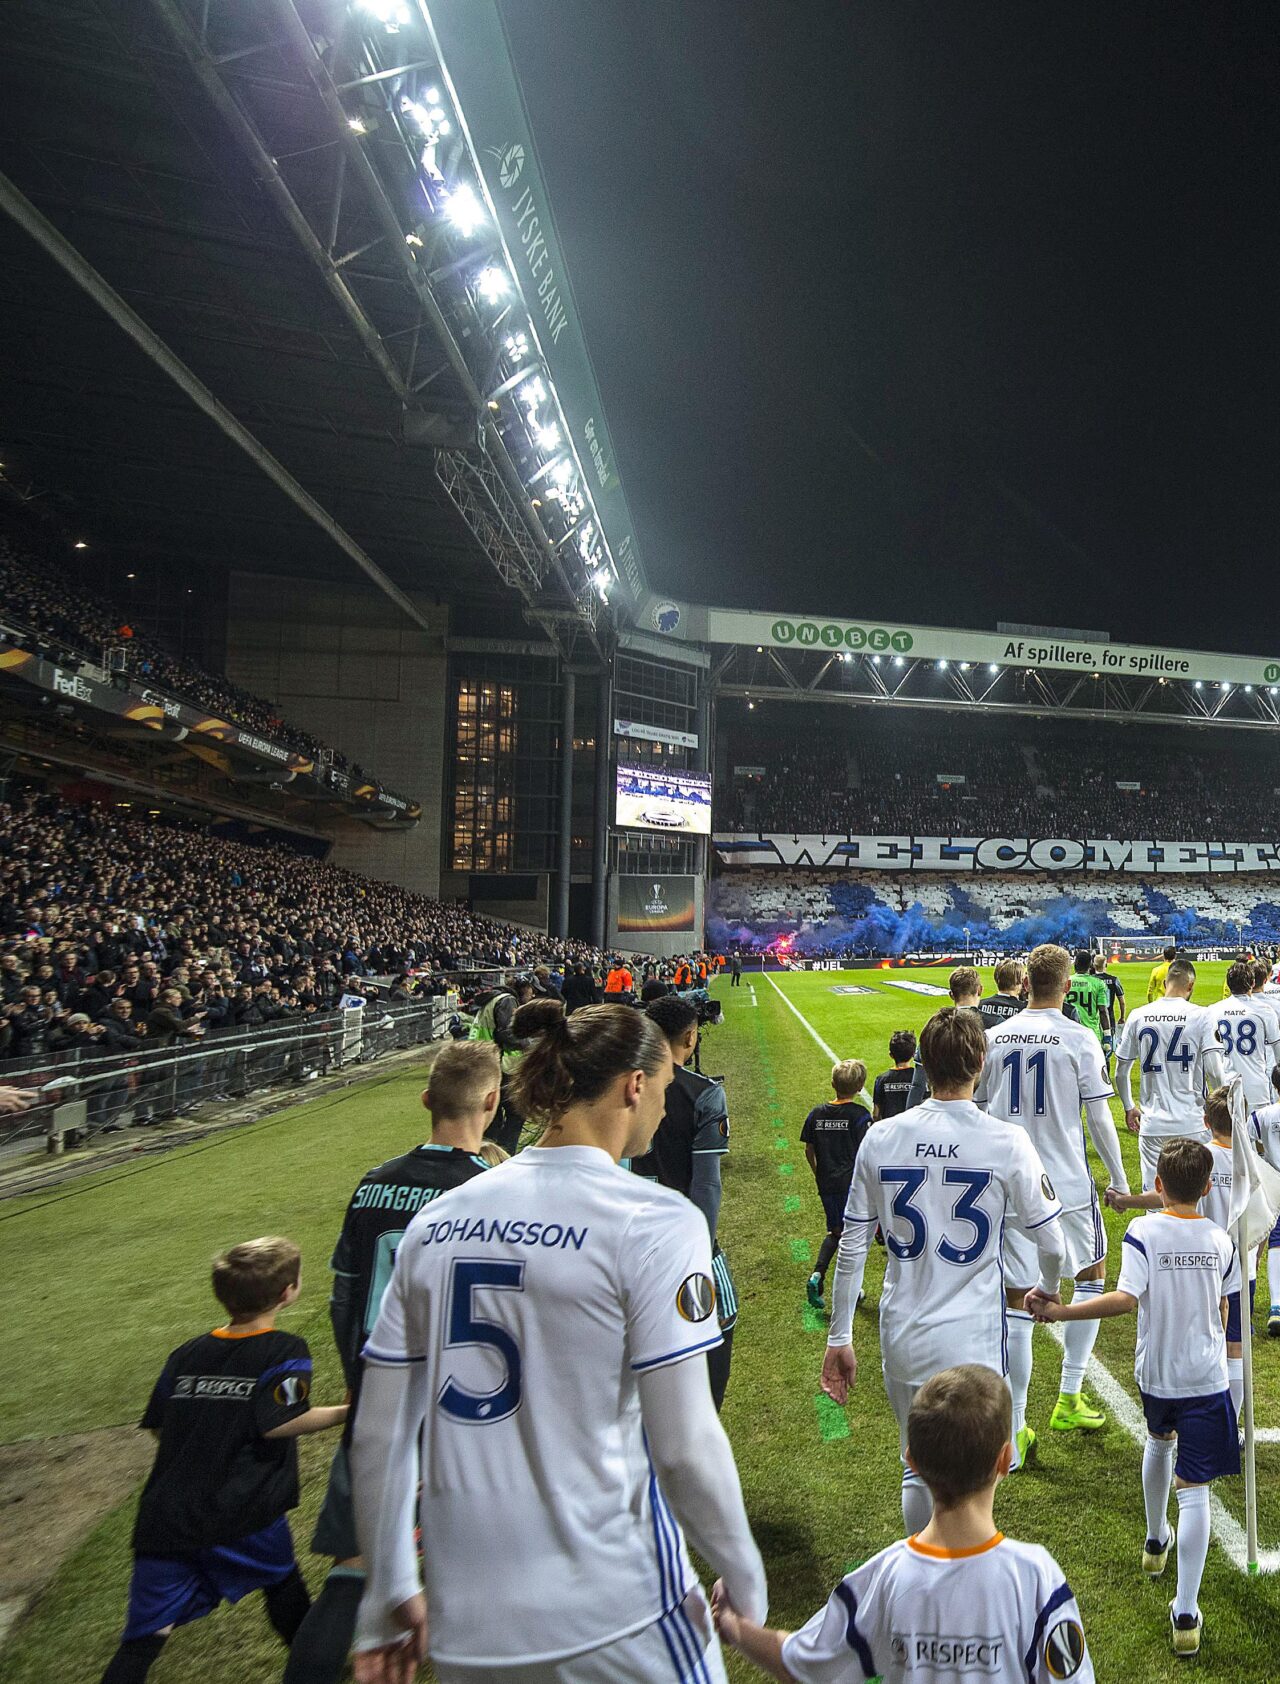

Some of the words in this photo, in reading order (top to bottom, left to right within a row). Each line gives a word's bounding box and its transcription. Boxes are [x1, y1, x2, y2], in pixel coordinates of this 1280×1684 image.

[511, 185, 548, 278] JYSKE
[537, 268, 568, 345] BANK
[771, 620, 914, 653] UNIBET
[1004, 642, 1024, 659] Af
[1027, 645, 1097, 668] spillere,
[1102, 650, 1126, 667] for
[1129, 653, 1190, 673] spillere
[53, 668, 93, 703] FedEx
[270, 746, 289, 761] LEAGUE
[812, 962, 845, 971] #UEL
[1196, 953, 1222, 962] #UEL
[981, 1004, 1019, 1017] DOLBERG
[1066, 991, 1092, 1016] 24
[1144, 1015, 1187, 1023] TOUTOUH
[994, 1034, 1060, 1046] CORNELIUS
[1138, 1025, 1195, 1074] 24
[1001, 1048, 1047, 1117] 11
[915, 1142, 960, 1159] FALK
[878, 1165, 993, 1266] 33
[421, 1217, 588, 1250] JOHANSSON
[1173, 1254, 1219, 1269] RESPECT
[436, 1256, 528, 1426] 5
[194, 1380, 257, 1396] RESPECT
[916, 1641, 1003, 1666] RESPECT
